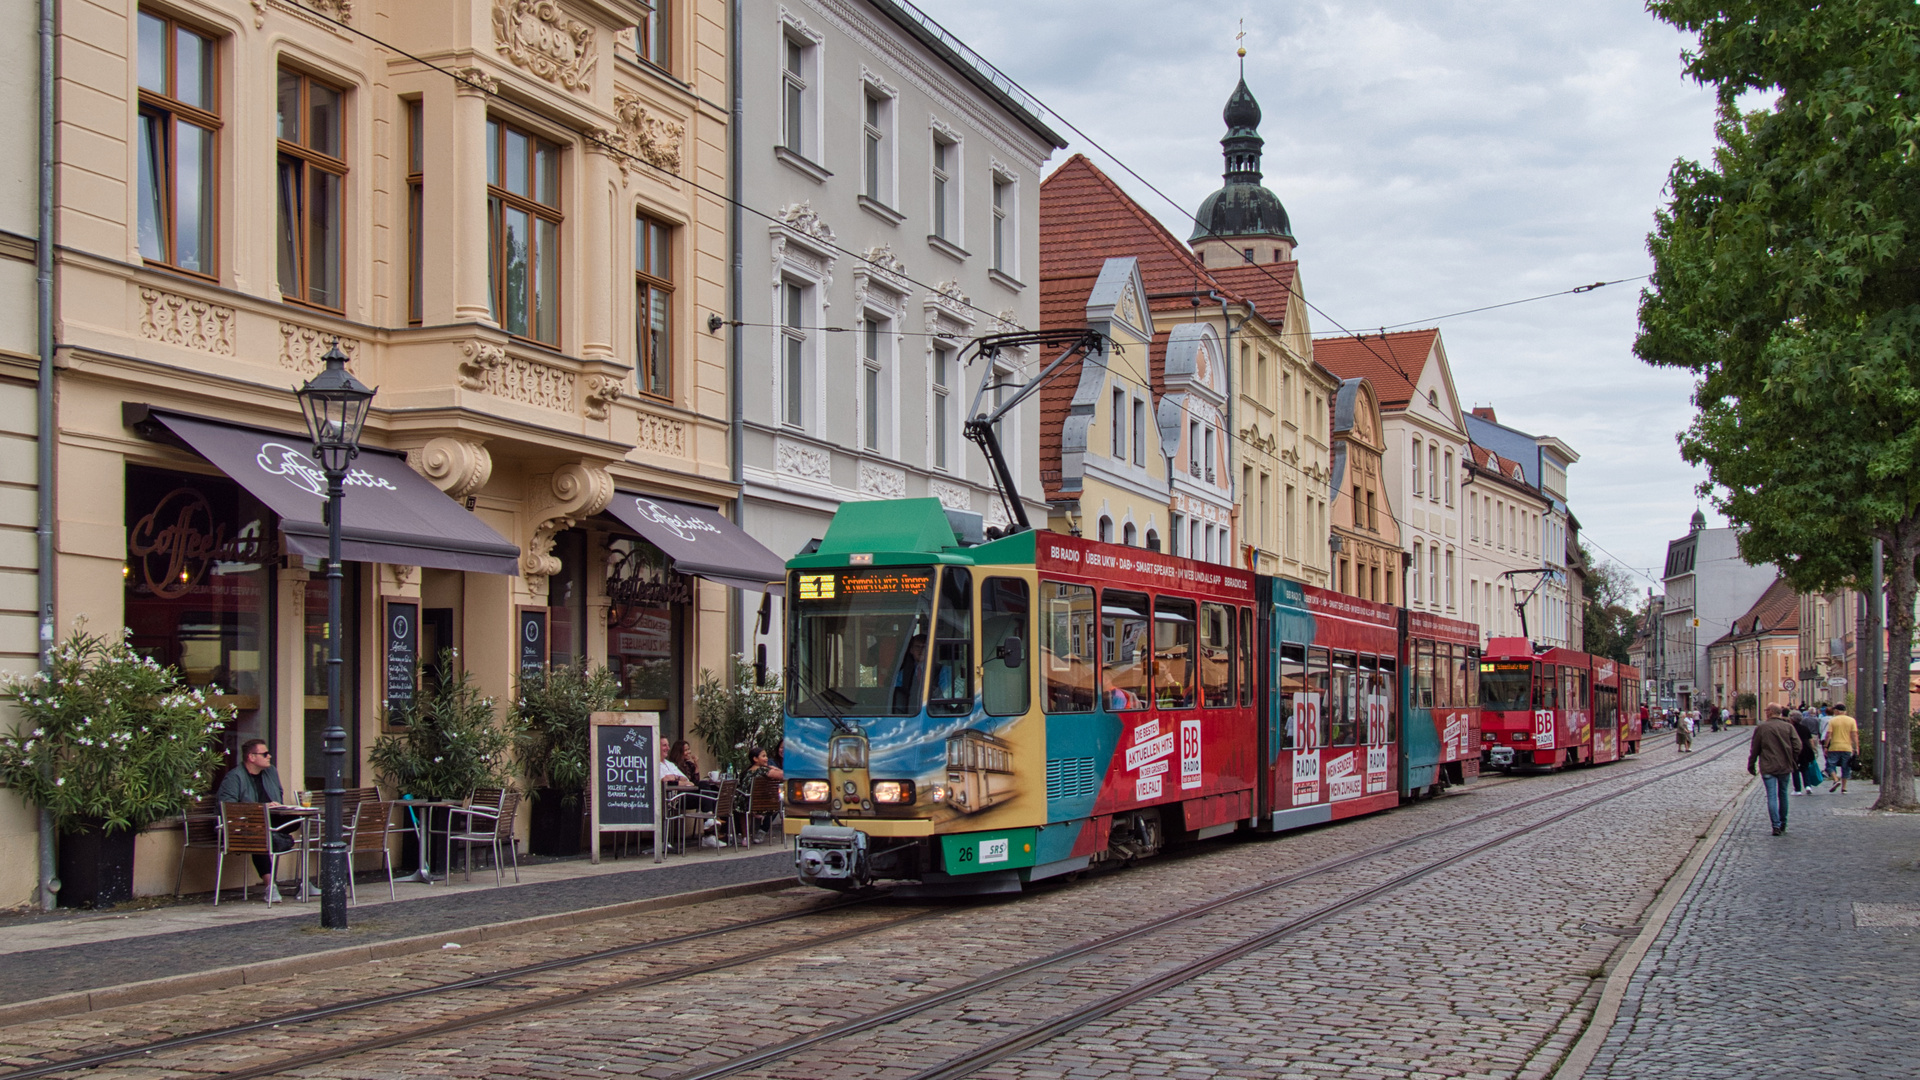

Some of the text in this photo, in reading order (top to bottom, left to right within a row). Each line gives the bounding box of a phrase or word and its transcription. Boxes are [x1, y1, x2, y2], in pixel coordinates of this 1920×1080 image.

[257, 446, 397, 496] Coffeeatte
[1050, 545, 1060, 559] BB
[1060, 547, 1080, 562] RADIO
[1085, 549, 1101, 566] ÜBER
[1101, 555, 1116, 568] UKW
[1136, 561, 1153, 574] SMART
[1153, 563, 1175, 578] SPEAKER
[1184, 568, 1194, 581] WEB
[1194, 570, 1204, 582] UND
[1204, 572, 1213, 584] ALS
[1212, 573, 1221, 585] APP
[812, 576, 822, 597] 1
[1135, 723, 1159, 740] DIE BESTEN
[1297, 702, 1317, 756] BB
[1370, 703, 1385, 750] BB
[1537, 712, 1552, 735] BB
[1183, 726, 1199, 759] BB
[1537, 734, 1553, 743] RADIO
[607, 744, 622, 755] WIR
[1128, 737, 1173, 766] AKTUELLEN HITS
[606, 755, 648, 769] SUCHEN
[1183, 760, 1199, 773] RADIO
[1296, 758, 1317, 777] RADIO
[1369, 752, 1386, 769] RADIO
[606, 768, 648, 784] DICH
[1137, 779, 1161, 797] VIELFALT
[958, 847, 973, 862] 26
[990, 844, 1004, 855] SRS
